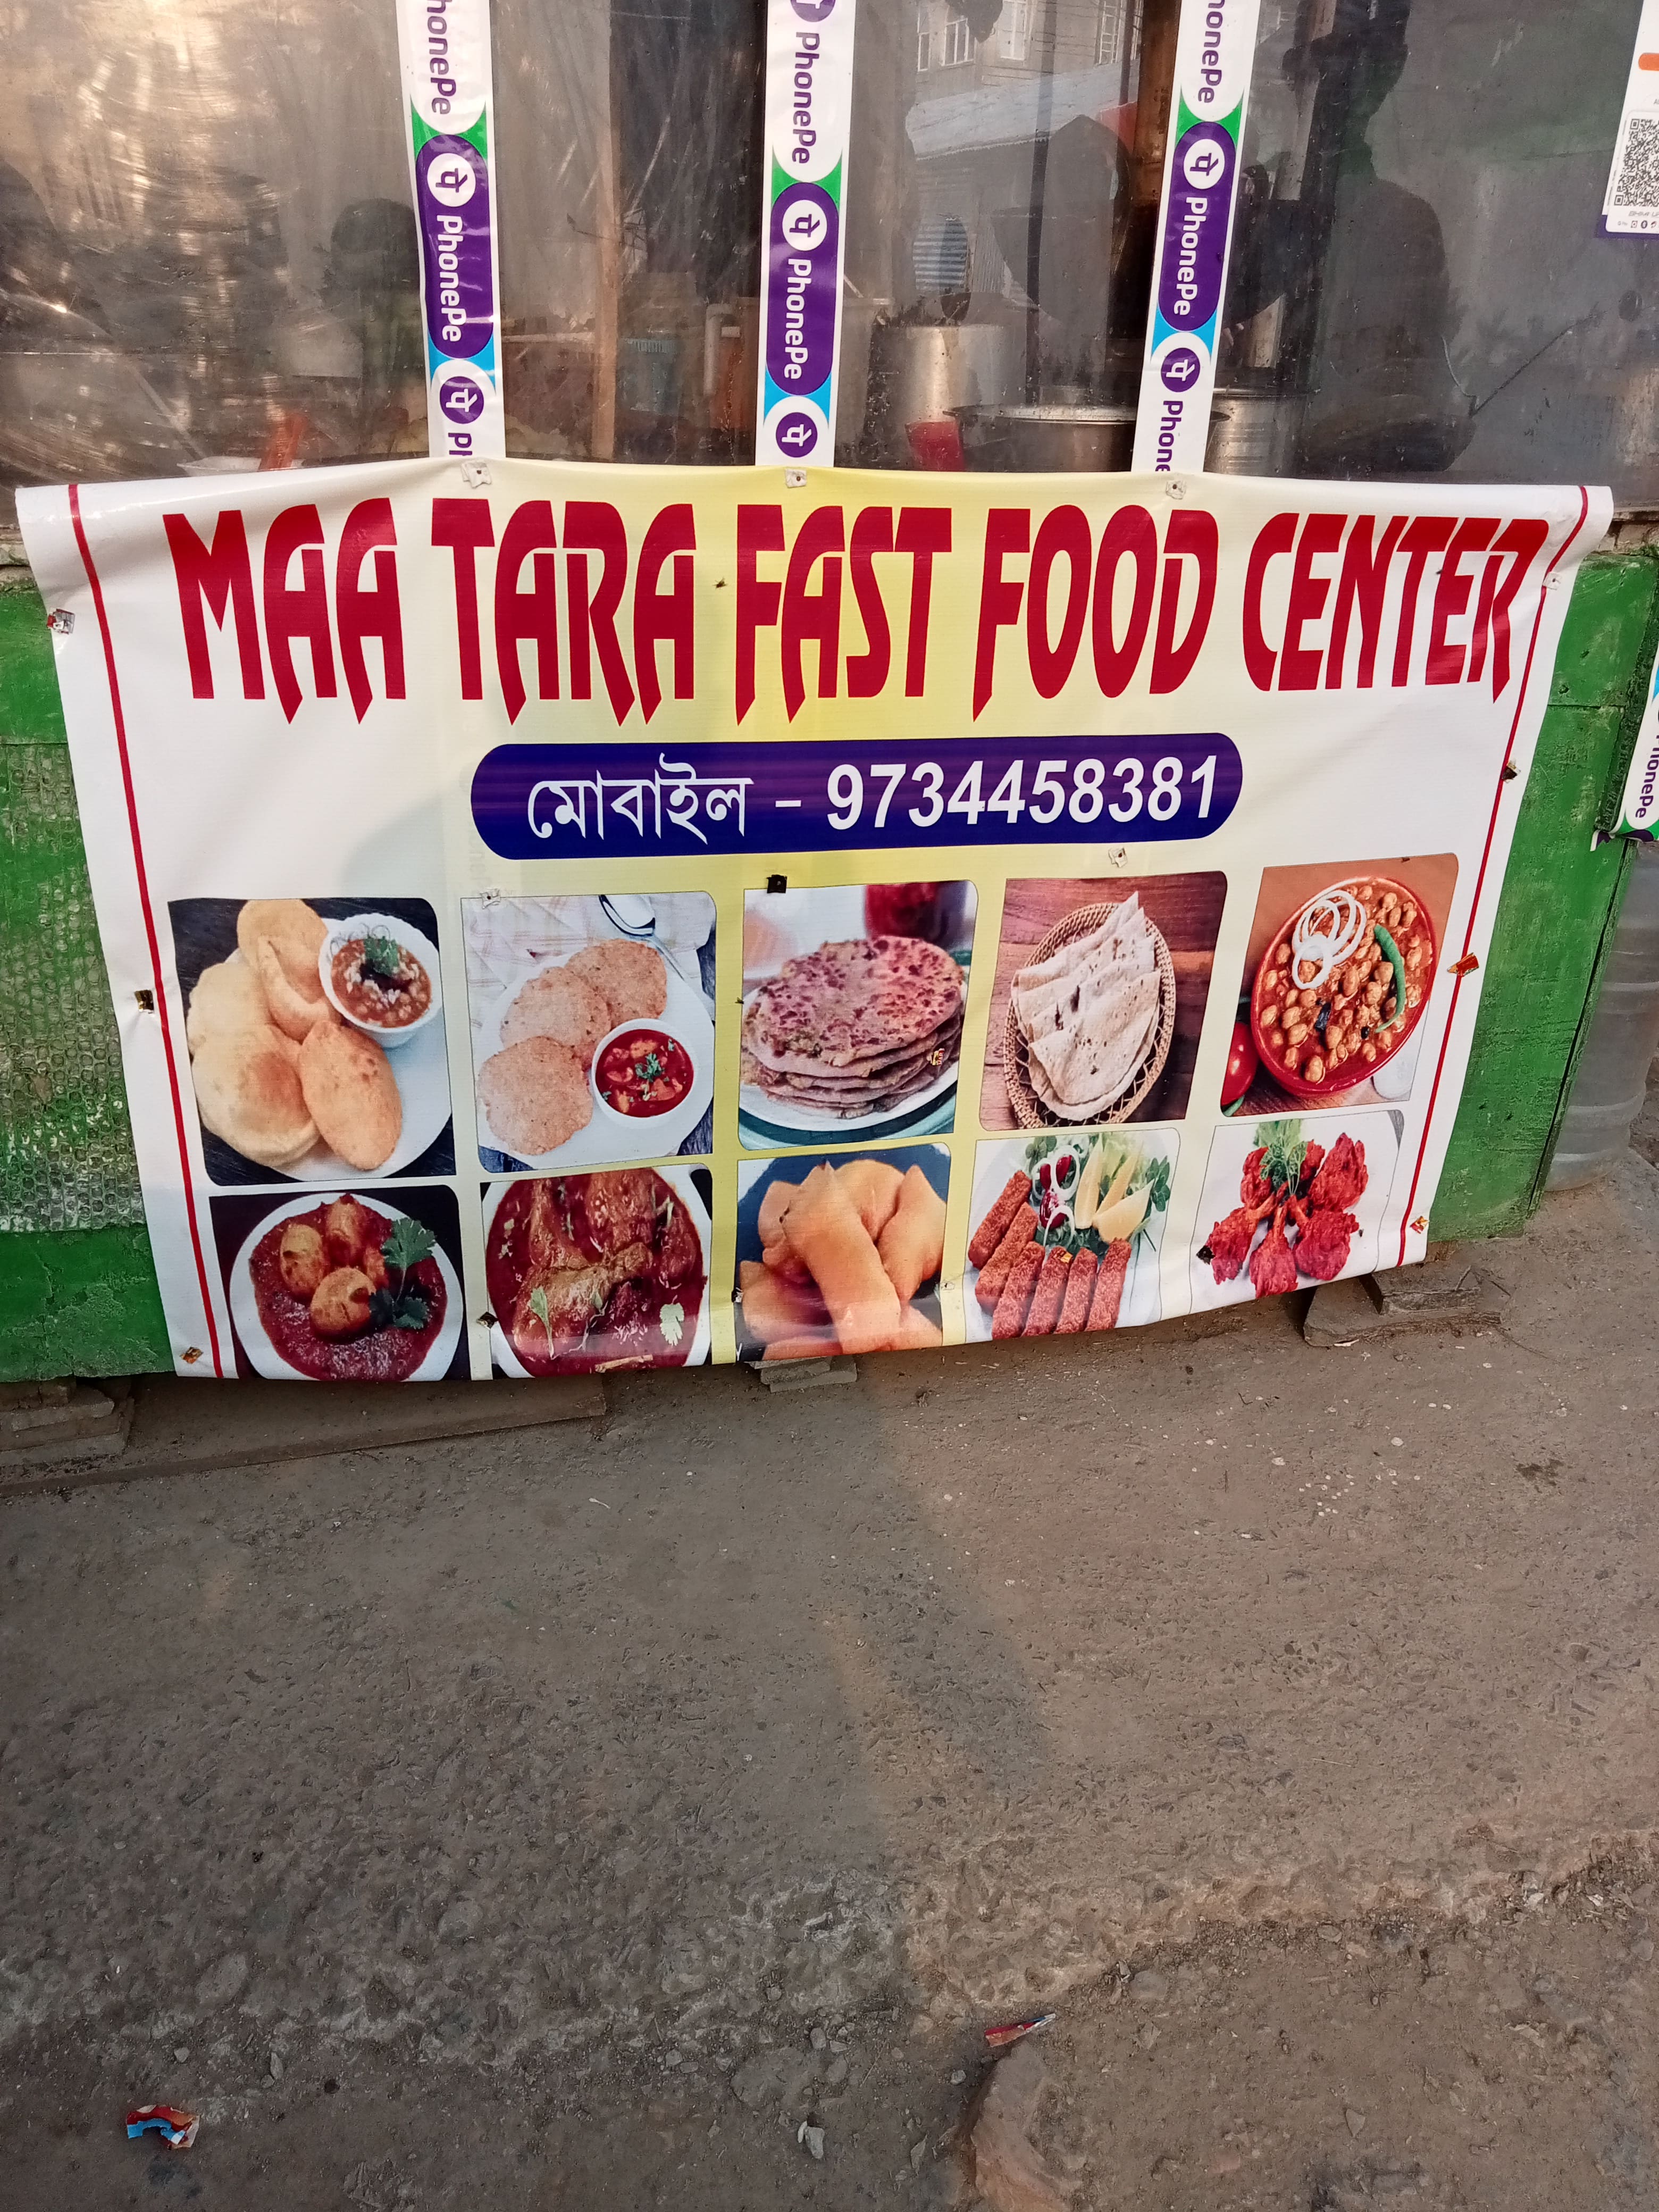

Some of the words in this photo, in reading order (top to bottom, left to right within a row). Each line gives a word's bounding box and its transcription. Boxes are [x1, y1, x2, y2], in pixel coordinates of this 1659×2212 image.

[427, 0, 456, 114] honePe
[792, 32, 819, 163] PhonePe
[1198, 0, 1225, 103] onePe
[437, 215, 466, 341] PhonePe
[1174, 197, 1207, 315] PhonePe
[784, 259, 811, 379] PhonePe
[163, 498, 406, 723] MAA
[432, 499, 696, 725] TARA
[736, 505, 951, 724] FAST
[973, 505, 1218, 720] FOOD
[1243, 513, 1549, 703] CENTER
[528, 753, 753, 844] মোবাইল
[827, 756, 1217, 830] 9734458381
[1636, 735, 1659, 818] onePe
